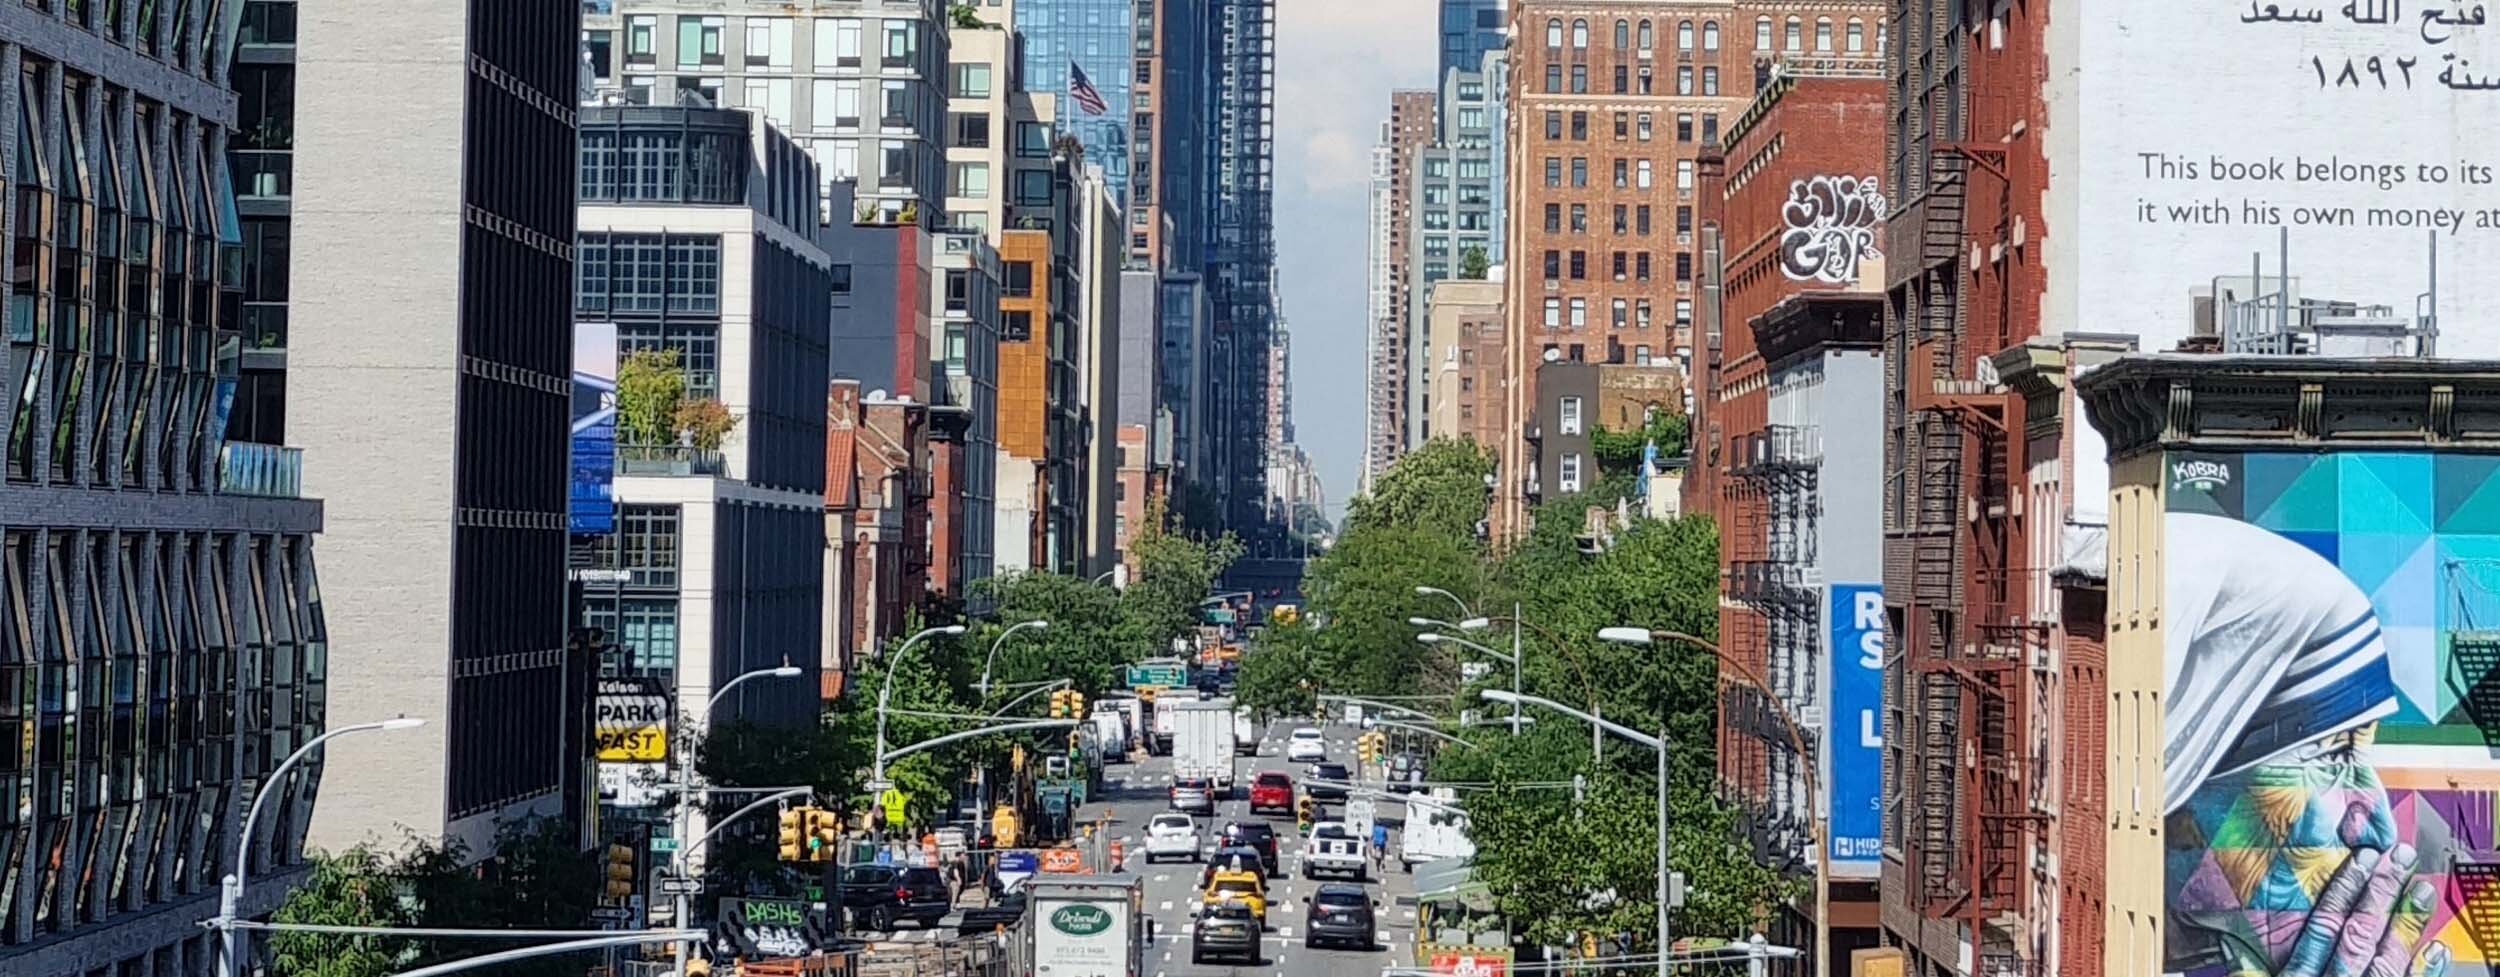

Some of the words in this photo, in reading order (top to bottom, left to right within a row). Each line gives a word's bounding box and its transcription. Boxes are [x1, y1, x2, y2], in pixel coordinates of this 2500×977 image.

[2312, 54, 2417, 90] ١٨٩٢
[2138, 152, 2198, 181] This
[2210, 155, 2285, 182] book
[2297, 155, 2406, 191] belongs
[2418, 162, 2448, 184] to
[2461, 159, 2492, 185] its
[2138, 198, 2157, 224] it
[2167, 198, 2230, 225] with
[2243, 200, 2281, 225] his
[2293, 206, 2354, 227] own
[2368, 207, 2466, 236] money
[2475, 208, 2500, 228] at
[2172, 461, 2229, 480] KOBRA
[598, 704, 658, 722] PARK
[598, 731, 657, 750] FAST
[1856, 838, 1882, 849] HID
